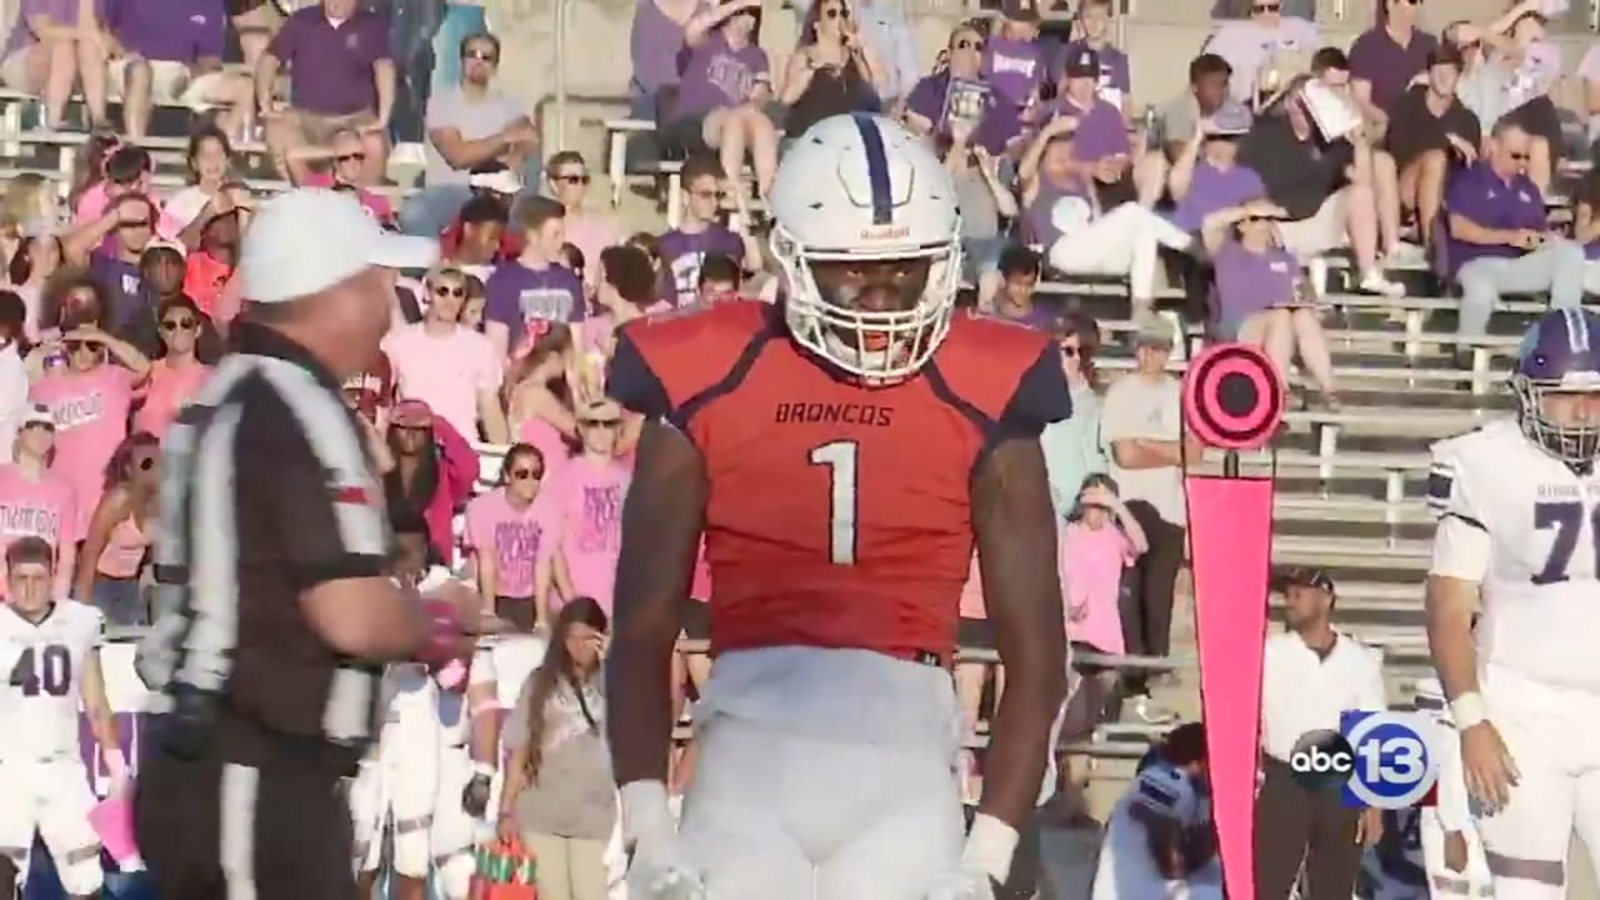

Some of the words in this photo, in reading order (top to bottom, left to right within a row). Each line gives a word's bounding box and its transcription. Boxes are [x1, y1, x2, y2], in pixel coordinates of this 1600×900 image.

[775, 402, 894, 427] BRONCOS
[807, 438, 860, 567] 1
[1530, 500, 1600, 586] 7
[9, 644, 72, 697] 40
